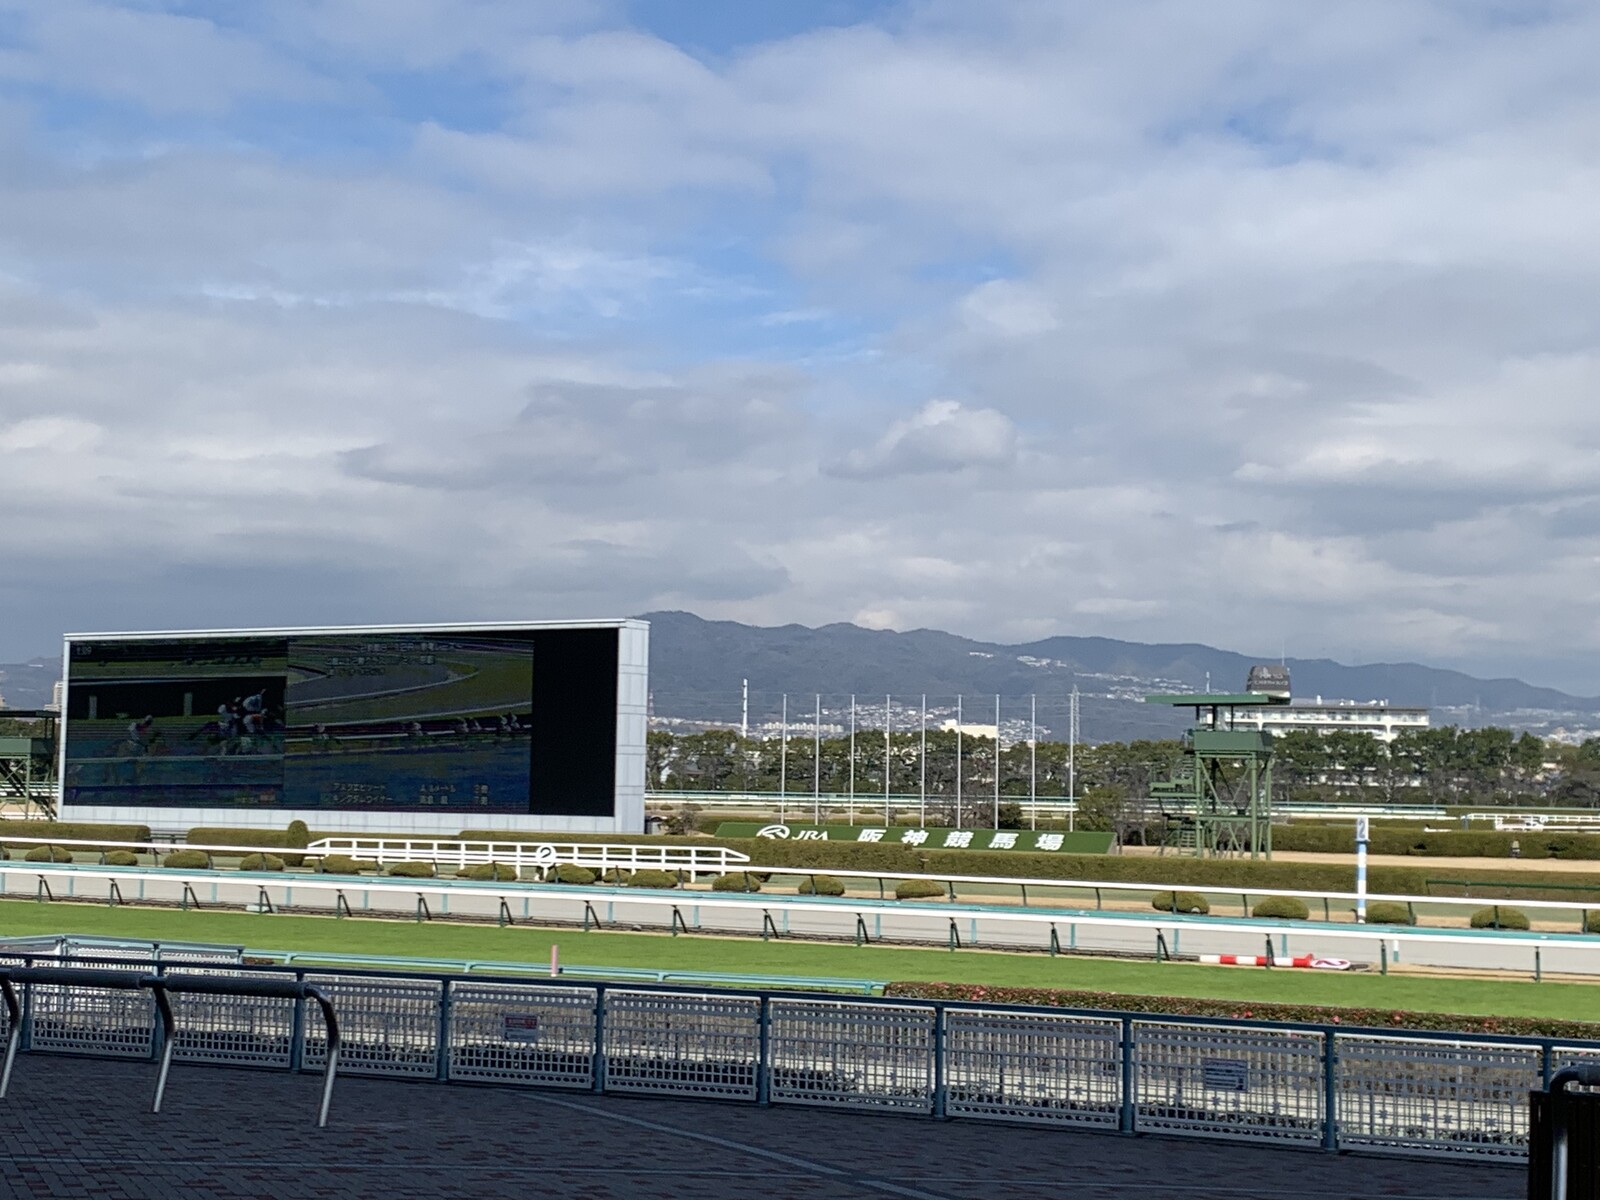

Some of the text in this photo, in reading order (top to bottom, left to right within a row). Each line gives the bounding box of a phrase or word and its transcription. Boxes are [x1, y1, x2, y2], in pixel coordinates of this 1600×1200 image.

[791, 830, 829, 841] JRA
[1358, 818, 1366, 839] 2
[856, 828, 1065, 851] 阪神競馬場
